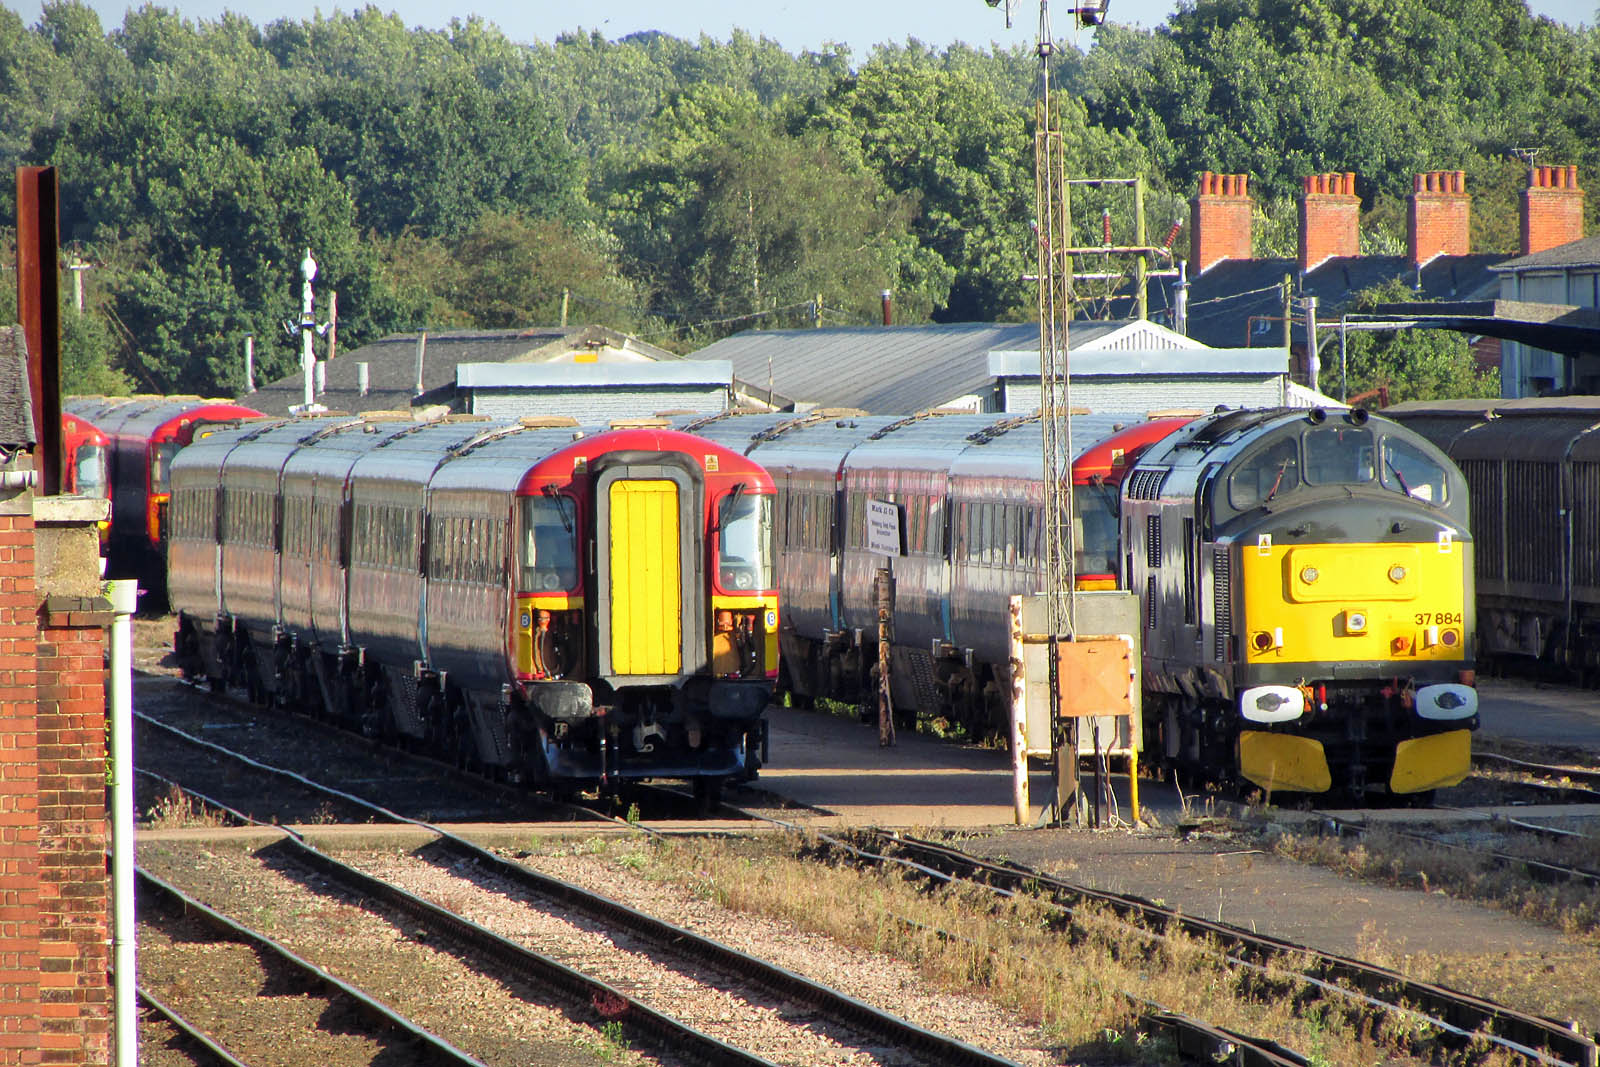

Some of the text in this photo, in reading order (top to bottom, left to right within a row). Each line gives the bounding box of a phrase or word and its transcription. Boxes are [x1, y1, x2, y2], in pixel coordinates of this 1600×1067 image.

[521, 615, 529, 625] B
[1415, 612, 1461, 625] 37 884
